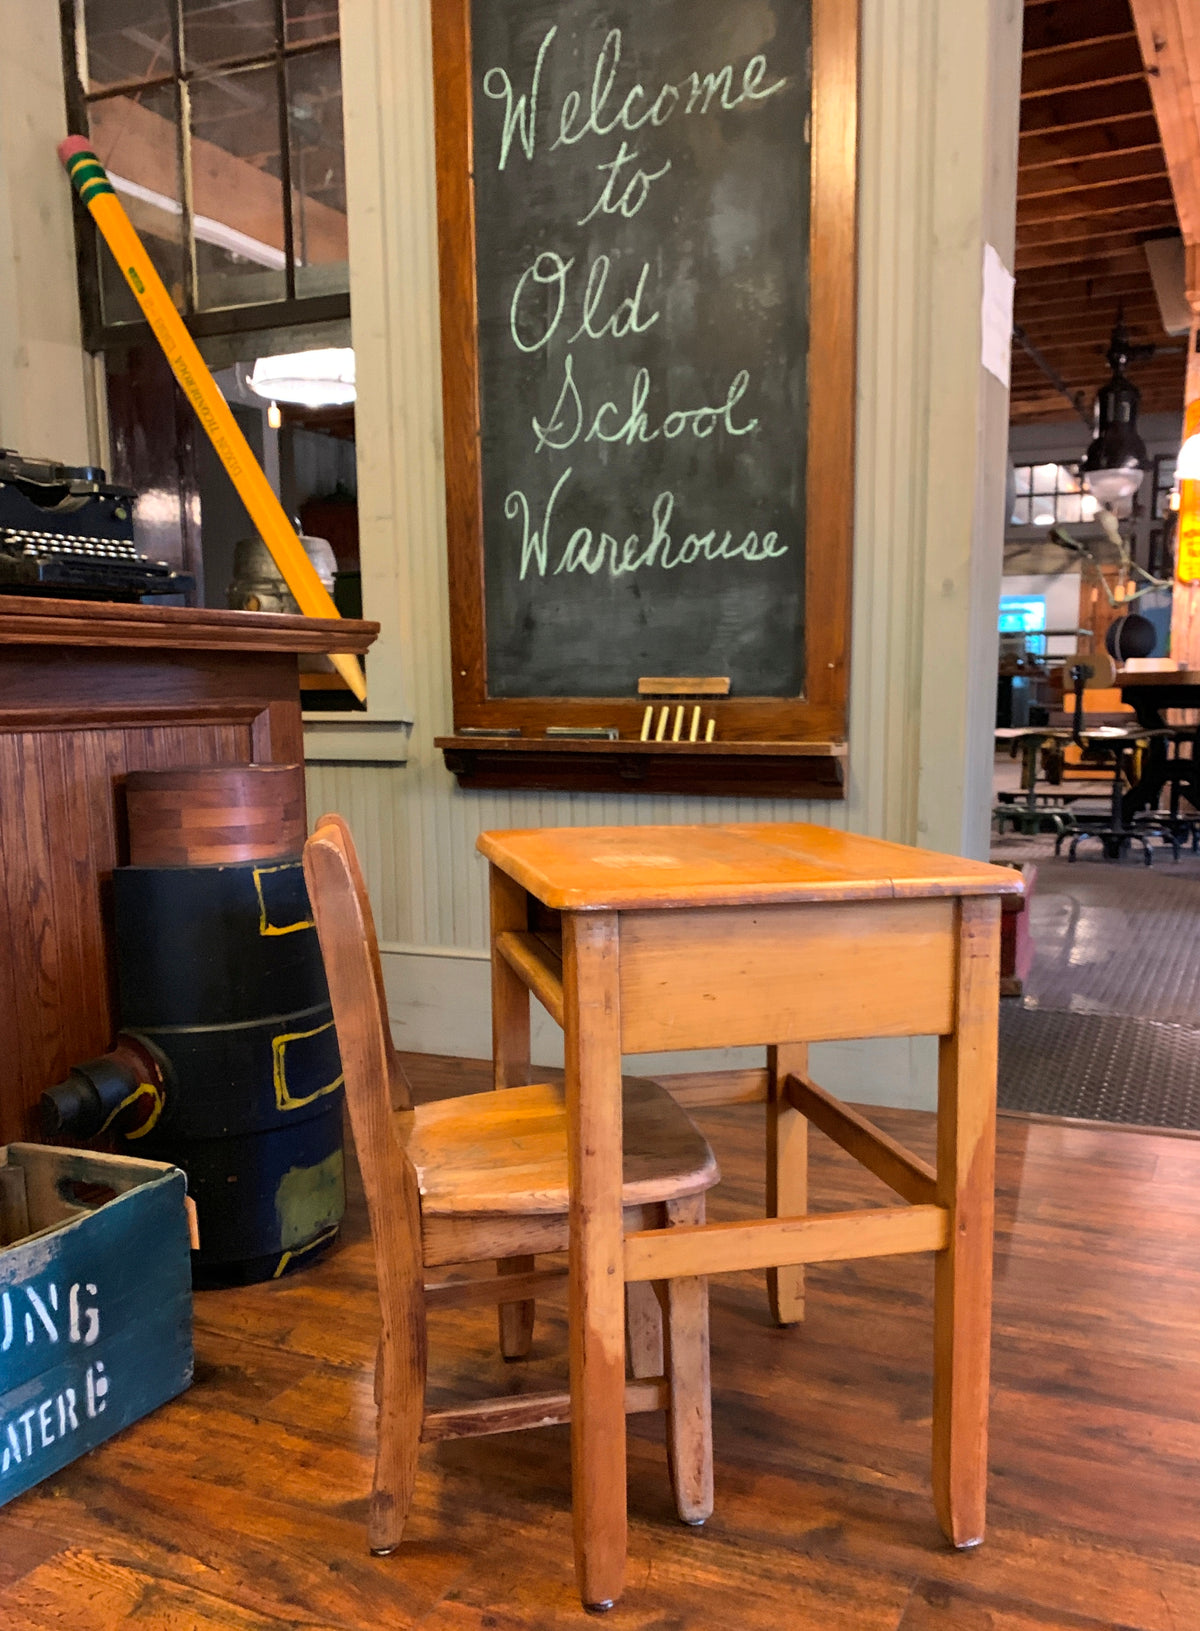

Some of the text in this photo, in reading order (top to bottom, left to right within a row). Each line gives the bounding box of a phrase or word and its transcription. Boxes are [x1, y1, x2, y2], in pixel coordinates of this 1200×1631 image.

[483, 25, 787, 171] Welcome
[577, 141, 672, 226] to
[510, 251, 660, 352] Old
[532, 353, 759, 453] School
[504, 467, 789, 581] Warehouse
